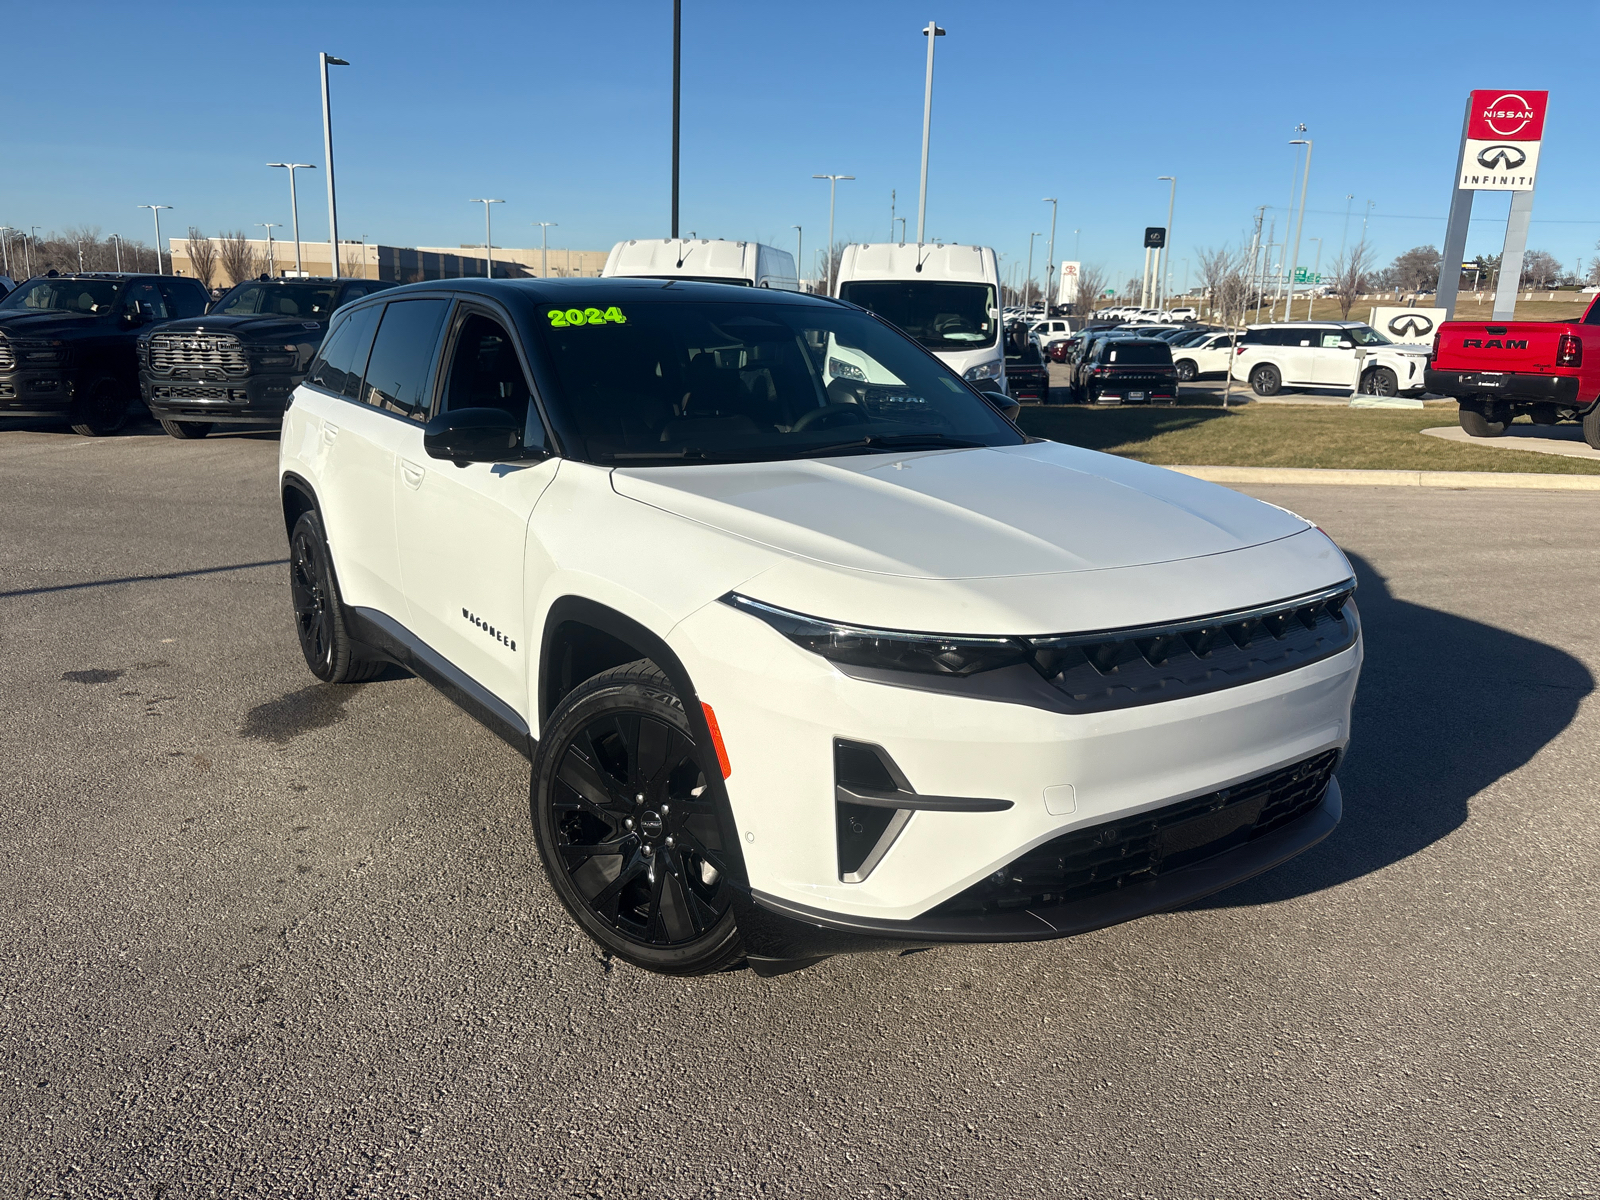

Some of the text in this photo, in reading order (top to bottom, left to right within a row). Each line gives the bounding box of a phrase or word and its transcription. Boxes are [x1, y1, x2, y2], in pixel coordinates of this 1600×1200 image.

[1483, 111, 1533, 119] NISSAN
[1464, 176, 1533, 185] INFINITI
[548, 306, 627, 328] 2024
[1463, 339, 1529, 350] RAM
[462, 607, 516, 652] WAGONEER
